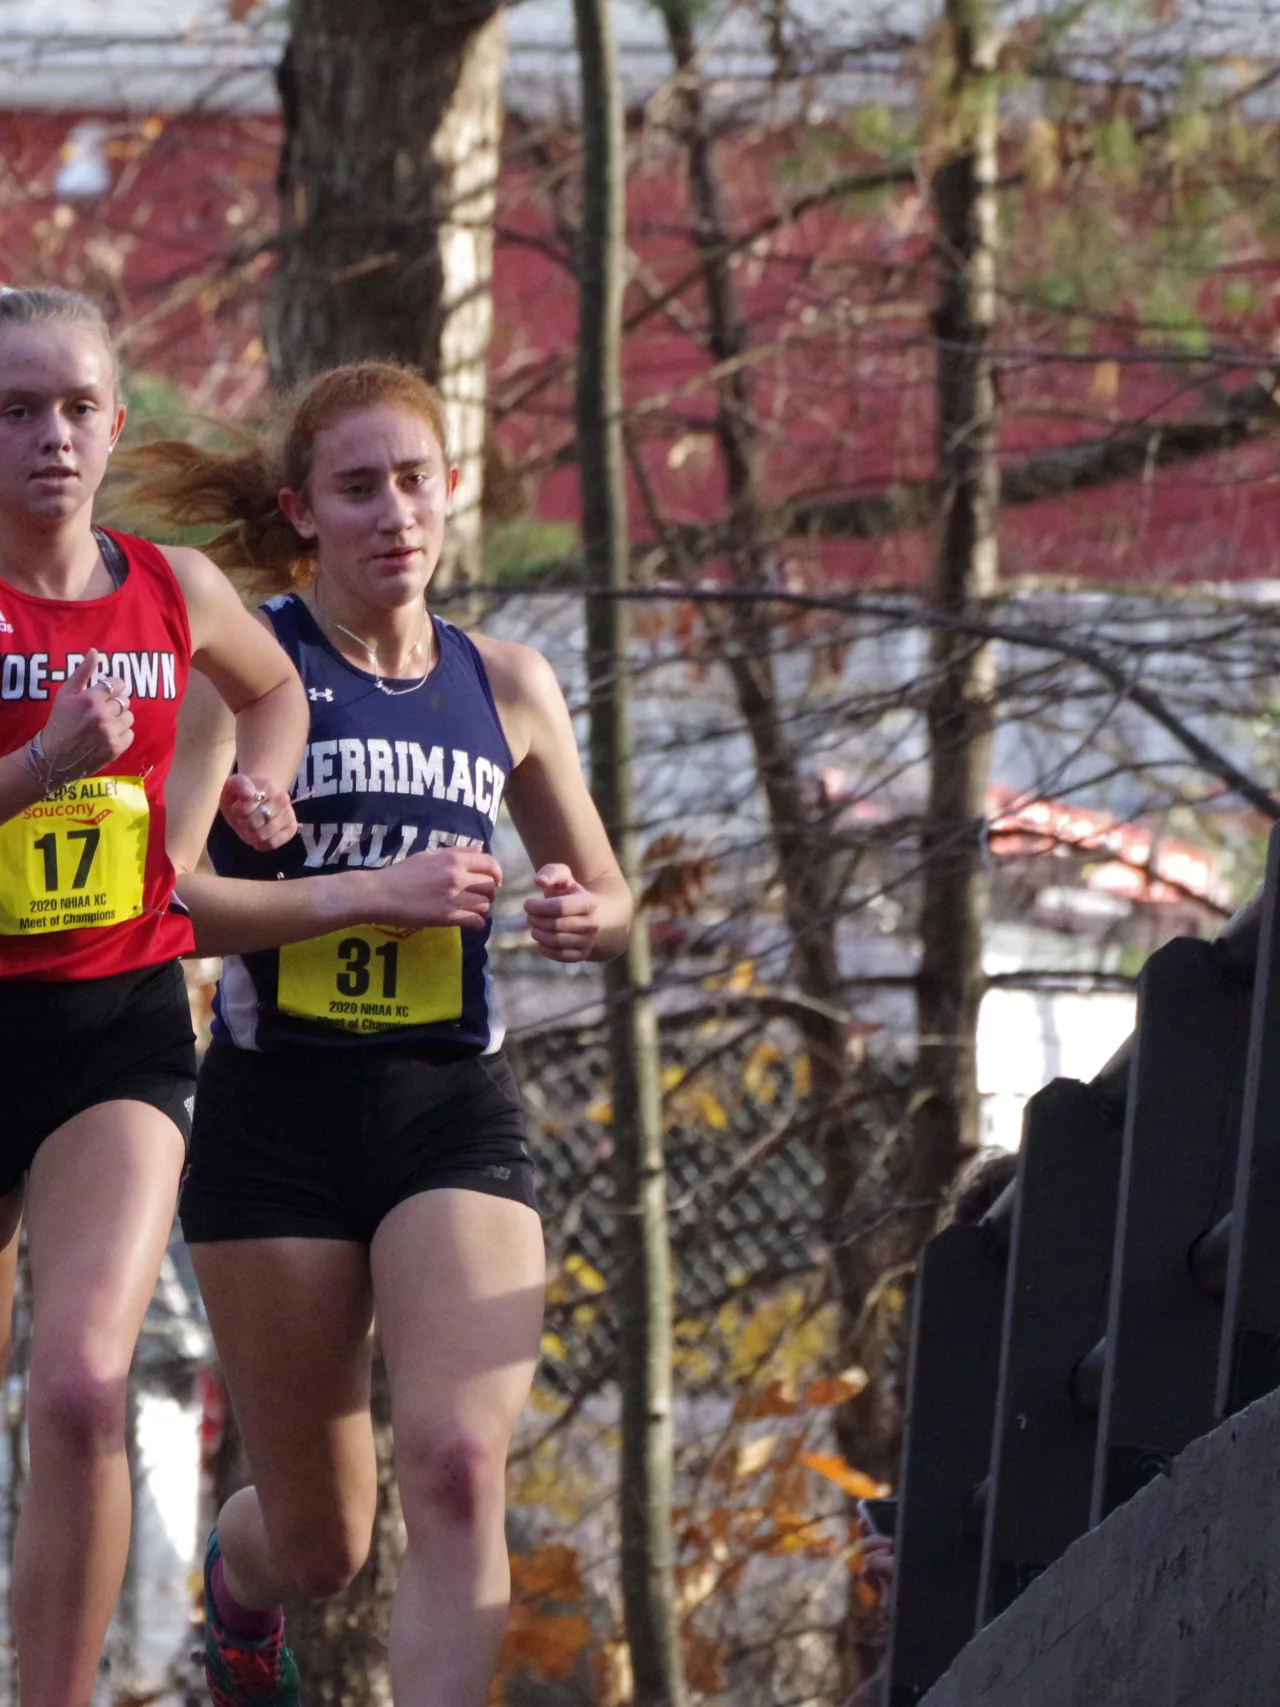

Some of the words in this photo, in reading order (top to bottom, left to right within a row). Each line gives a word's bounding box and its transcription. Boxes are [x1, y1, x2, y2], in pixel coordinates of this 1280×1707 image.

[80, 781, 118, 799] ALLEY
[23, 802, 96, 820] saucony
[33, 828, 101, 892] 17
[29, 899, 57, 913] 2020
[60, 895, 90, 910] NHIAA
[94, 893, 107, 906] XC
[20, 915, 46, 930] Meet
[50, 914, 60, 926] of
[63, 909, 116, 925] Champions
[336, 938, 399, 998] 31
[329, 1000, 358, 1014] 2020
[360, 1003, 392, 1016] NHIAA
[395, 1005, 409, 1018] XC
